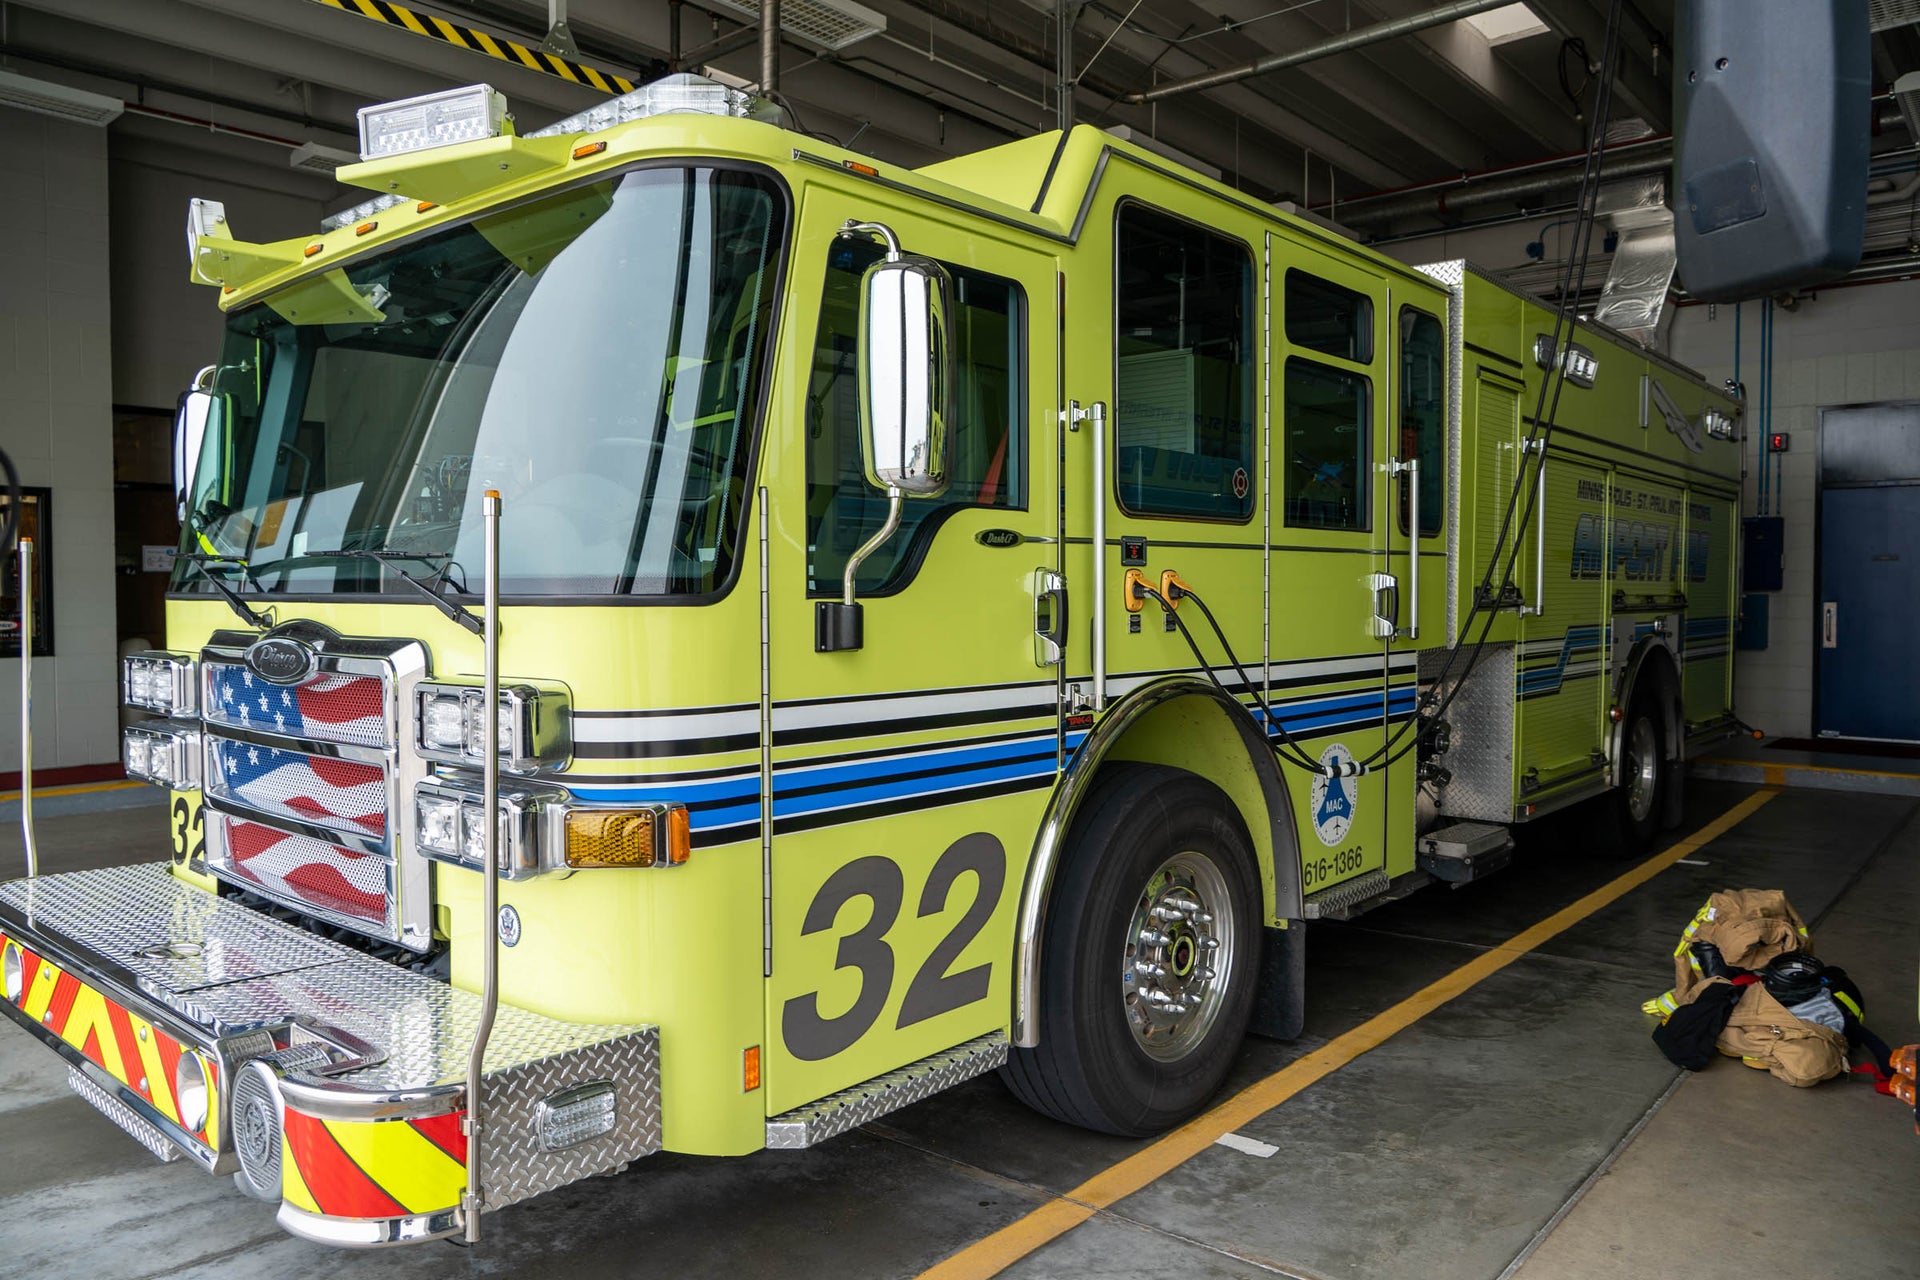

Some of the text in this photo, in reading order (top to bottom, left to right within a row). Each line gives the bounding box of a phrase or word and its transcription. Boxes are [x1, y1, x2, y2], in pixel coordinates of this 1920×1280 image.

[1326, 797, 1343, 814] MAC
[1304, 845, 1363, 887] 616-1366
[782, 832, 1007, 1061] 32
